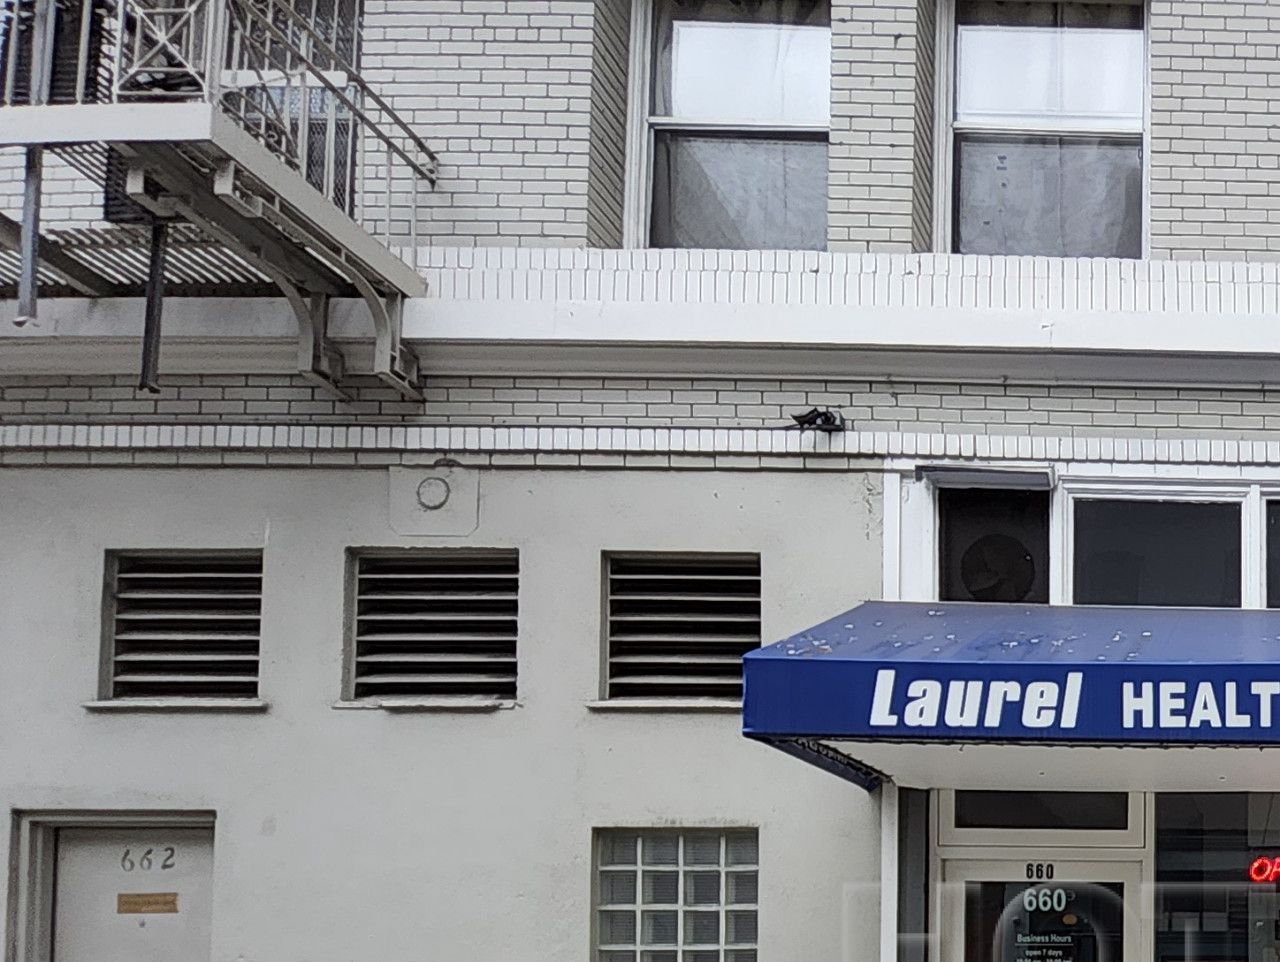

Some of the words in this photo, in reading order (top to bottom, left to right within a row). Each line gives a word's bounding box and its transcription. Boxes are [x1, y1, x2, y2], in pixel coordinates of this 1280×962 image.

[869, 668, 1083, 729] Laurel
[121, 846, 176, 872] 662
[1026, 863, 1054, 879] 660
[1023, 888, 1067, 912] 660
[1017, 934, 1049, 943] Business
[1050, 934, 1072, 943] Hours
